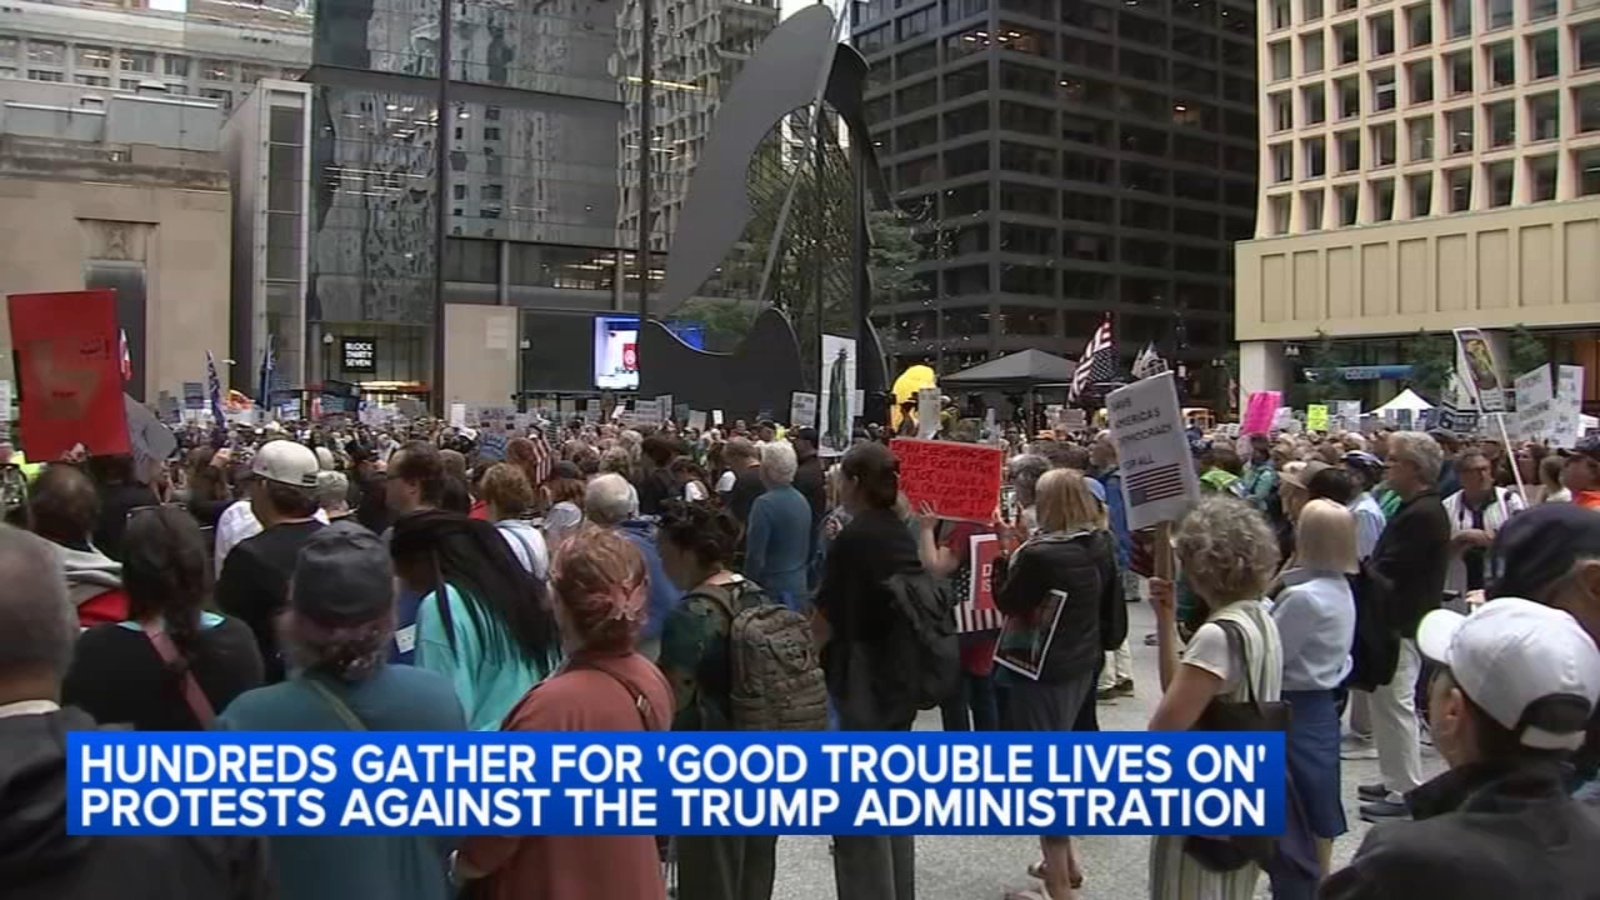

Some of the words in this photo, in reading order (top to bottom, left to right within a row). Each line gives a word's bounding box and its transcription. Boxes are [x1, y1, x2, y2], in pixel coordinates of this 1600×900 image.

[345, 342, 373, 351] BLOCK
[346, 350, 373, 358] THIRTY
[346, 358, 372, 367] SEVEN
